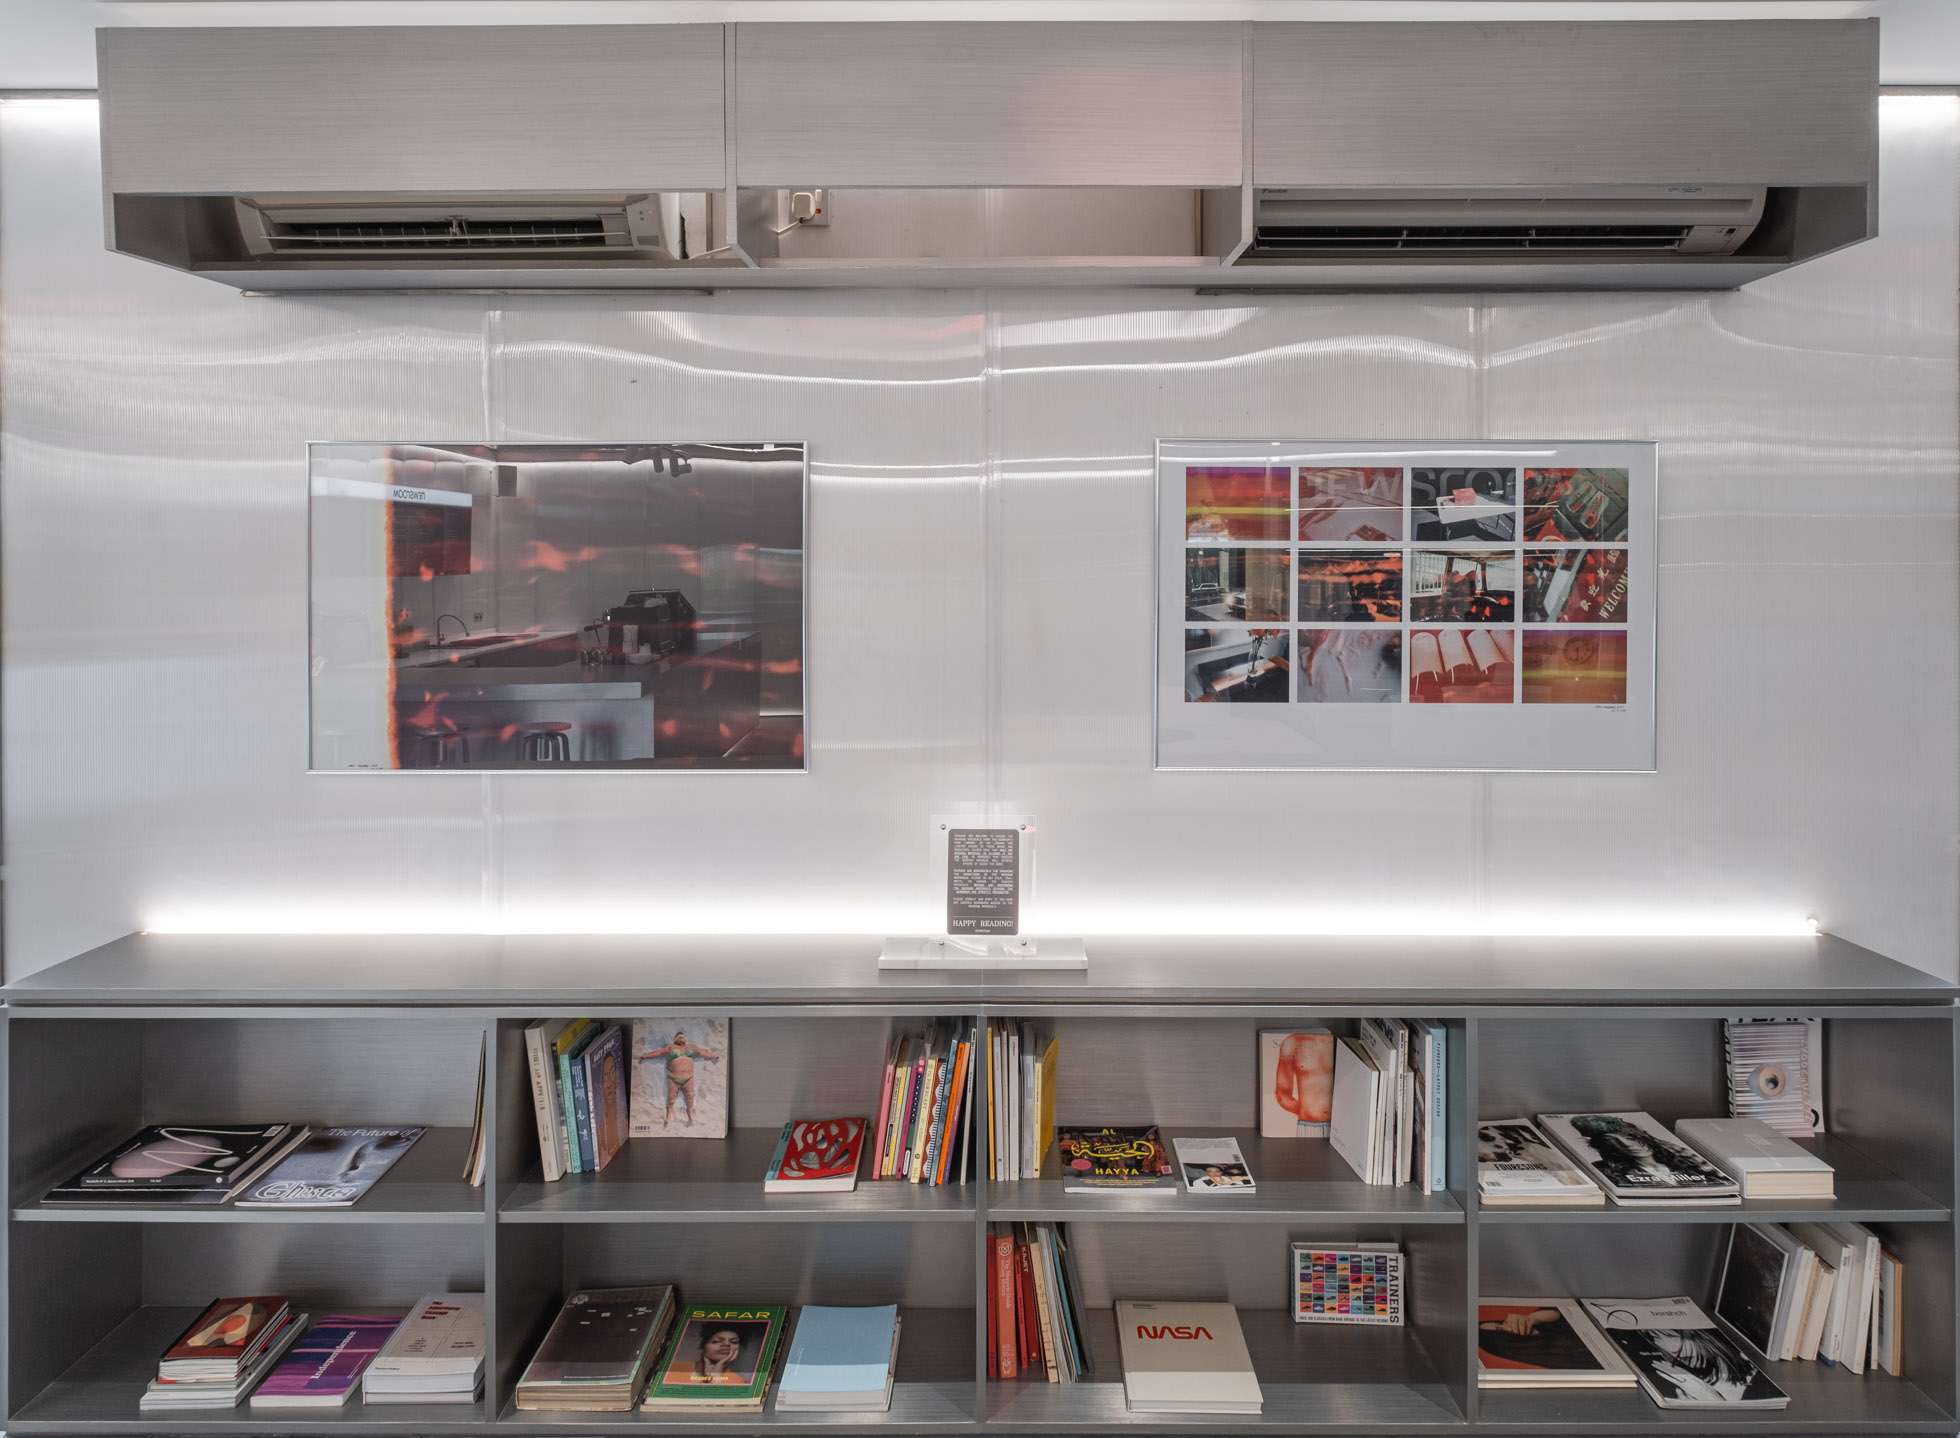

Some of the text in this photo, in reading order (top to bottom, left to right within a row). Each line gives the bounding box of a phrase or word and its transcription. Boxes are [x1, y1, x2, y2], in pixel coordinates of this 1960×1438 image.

[980, 920, 1014, 928] READING!
[922, 1078, 930, 1109] FORECAST
[328, 1128, 422, 1138] The Future of
[1625, 1173, 1706, 1182] Ezra Miller
[1020, 1246, 1028, 1272] KAJET
[1389, 1256, 1399, 1324] TRAINERS
[692, 1310, 771, 1319] SAFAR
[1137, 1325, 1213, 1340] NASA
[310, 1330, 357, 1379] Independence
